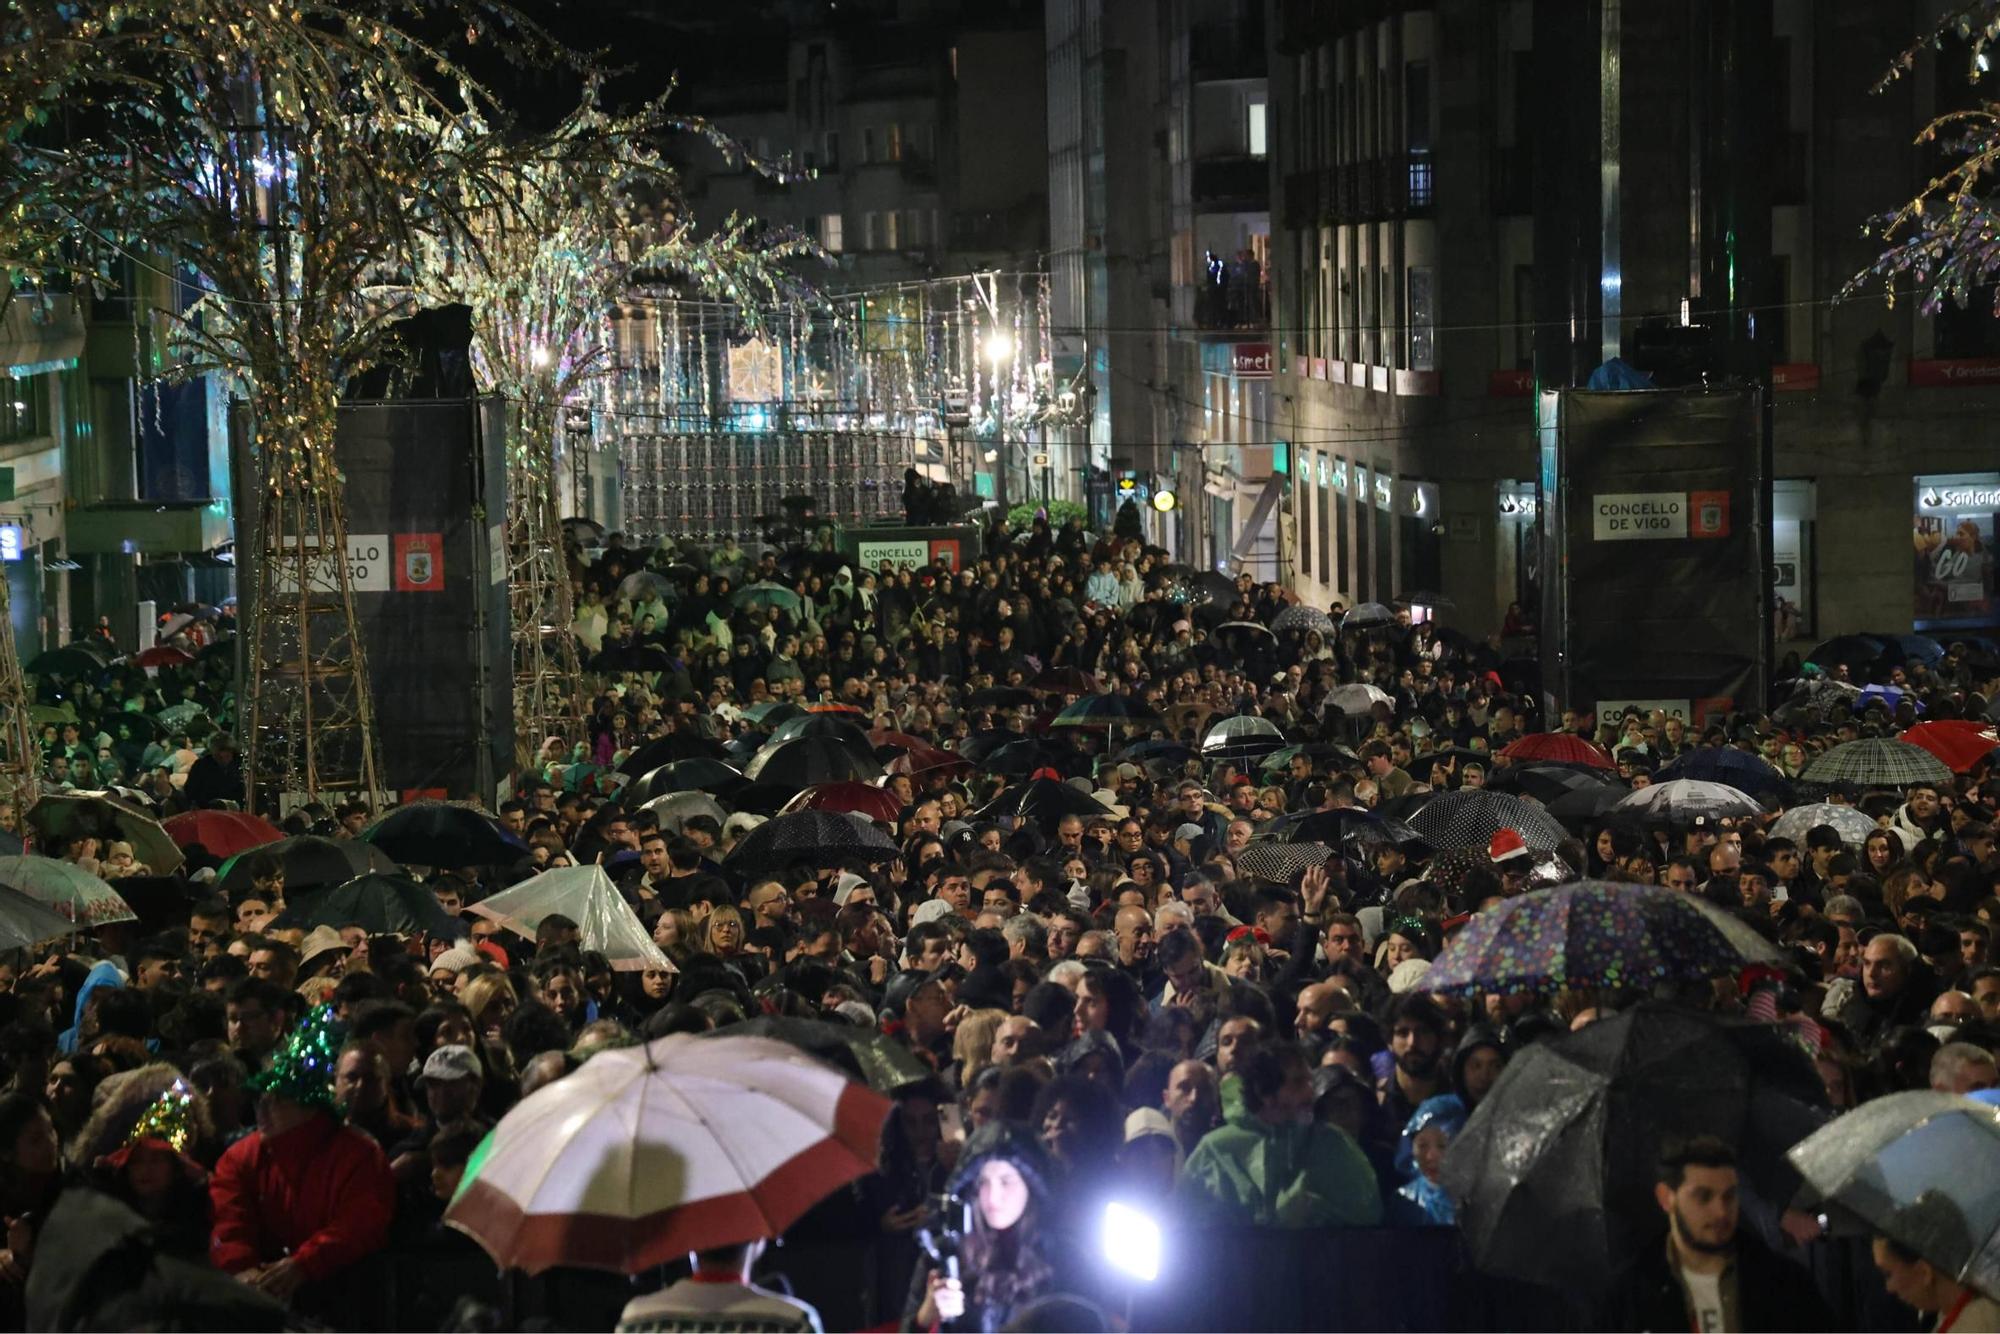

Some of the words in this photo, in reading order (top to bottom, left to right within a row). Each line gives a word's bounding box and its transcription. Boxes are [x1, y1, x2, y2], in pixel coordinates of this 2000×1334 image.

[1945, 490, 2000, 506] Santan
[1600, 503, 1679, 515] CONCELLO
[1610, 519, 1628, 530] DE
[1634, 517, 1670, 529] VIGO
[863, 548, 922, 558] CONCELLO
